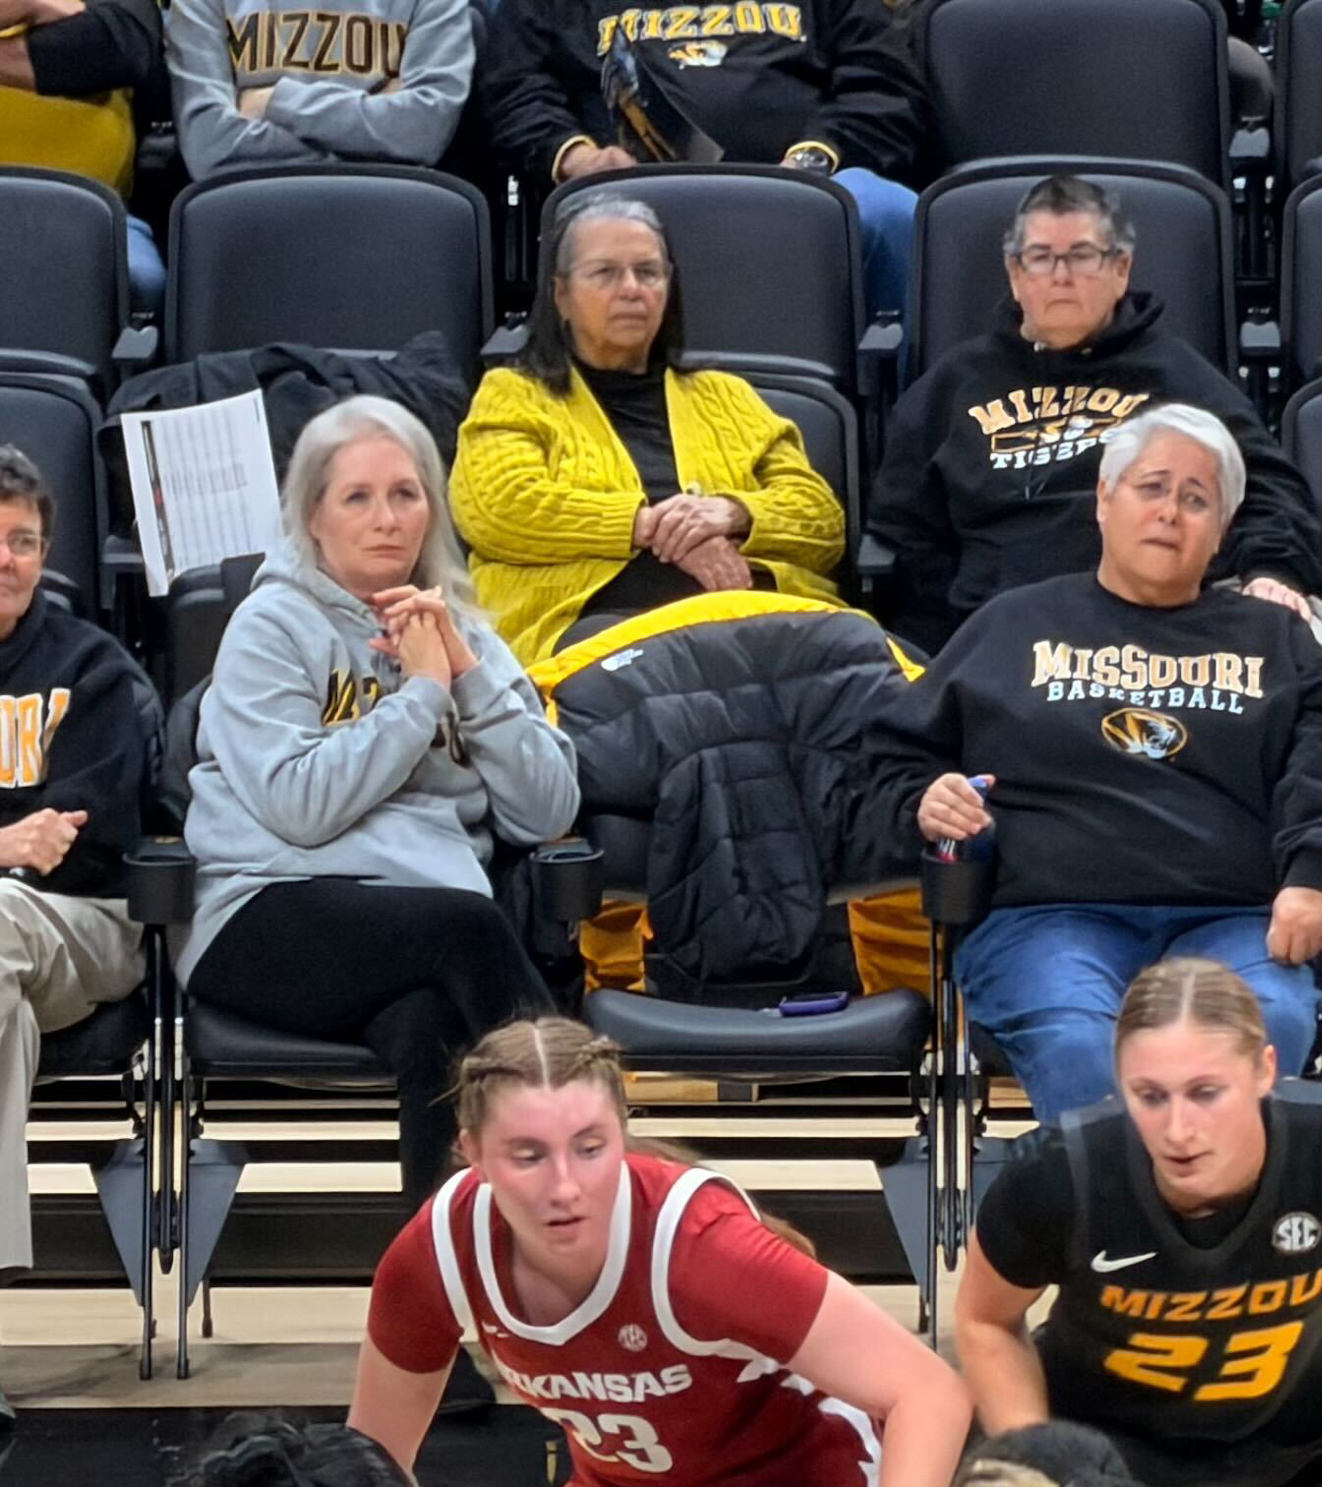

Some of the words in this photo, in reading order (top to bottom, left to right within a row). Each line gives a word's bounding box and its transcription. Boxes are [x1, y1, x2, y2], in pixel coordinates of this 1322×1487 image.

[226, 11, 407, 78] MIZZOU
[968, 385, 1150, 436] MIZZOU
[1031, 640, 1264, 698] MISSOURI
[1047, 681, 1244, 715] BASKETBALL
[1273, 1214, 1321, 1253] SEC
[1103, 1320, 1304, 1400] 23
